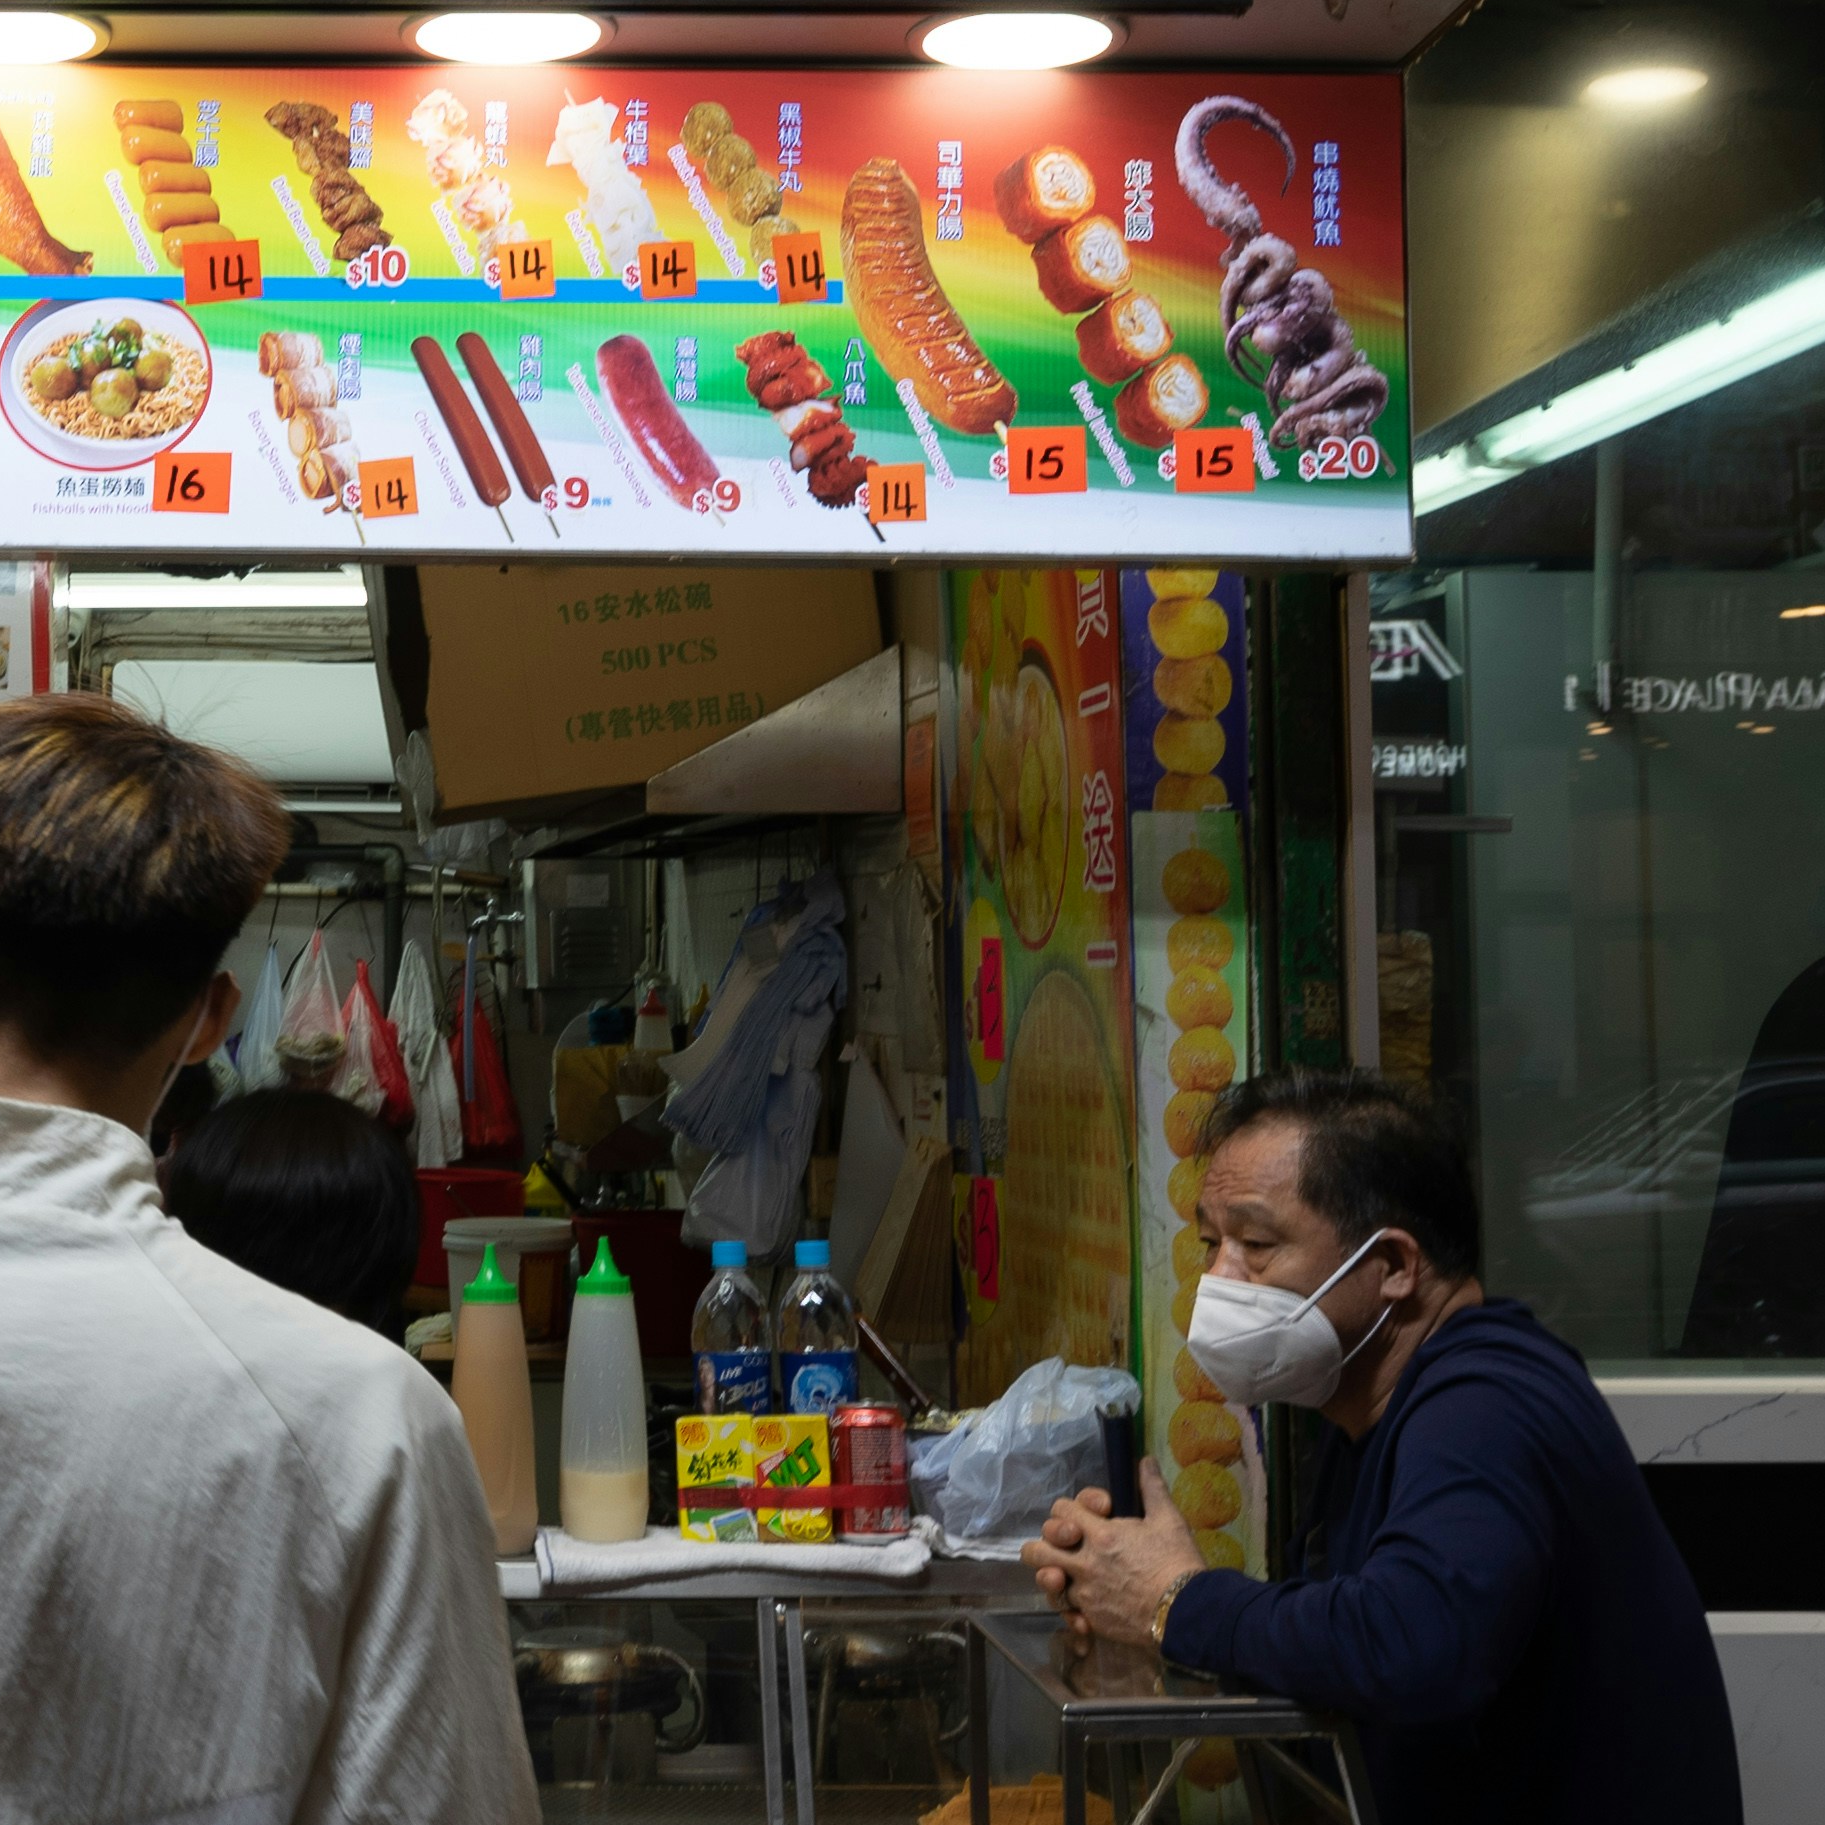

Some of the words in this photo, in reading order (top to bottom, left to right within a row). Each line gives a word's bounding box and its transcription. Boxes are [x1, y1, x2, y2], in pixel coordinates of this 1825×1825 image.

[194, 99, 220, 168] 芝士腸
[776, 102, 803, 193] 黑椒牛丸
[936, 141, 964, 242] 司華力腸
[1124, 159, 1154, 242] 炸大腸
[1312, 141, 1342, 247] 串燒魷魚
[106, 173, 134, 217] Cheese
[127, 217, 161, 273] Sausages
[209, 254, 252, 295] 14
[349, 250, 406, 288] $10
[508, 247, 547, 281] 14
[651, 248, 688, 288] 14
[787, 250, 825, 291] 14
[337, 333, 362, 401] 煙肉腸
[518, 334, 543, 402] 雞肉腸
[843, 338, 868, 406] 八爪魚
[566, 364, 605, 421] Taiwanese
[619, 459, 652, 507] Sausage
[1092, 418, 1134, 484] Intestines
[265, 447, 298, 504] Sausages
[414, 411, 443, 458] Chicken
[434, 457, 465, 507] Sausage
[1026, 446, 1064, 480] 15
[1196, 446, 1234, 478] 15
[1301, 442, 1379, 478] $20
[56, 476, 145, 498] 魚蛋撈麵
[166, 467, 205, 502] 16
[375, 479, 408, 511] 14
[543, 478, 590, 511] $9
[694, 481, 741, 514] $9
[768, 458, 798, 506] Octopus
[882, 482, 917, 516] 14
[33, 503, 86, 515] Fishballs
[88, 503, 115, 515] with
[601, 645, 651, 675] 500
[657, 637, 718, 667] PCS
